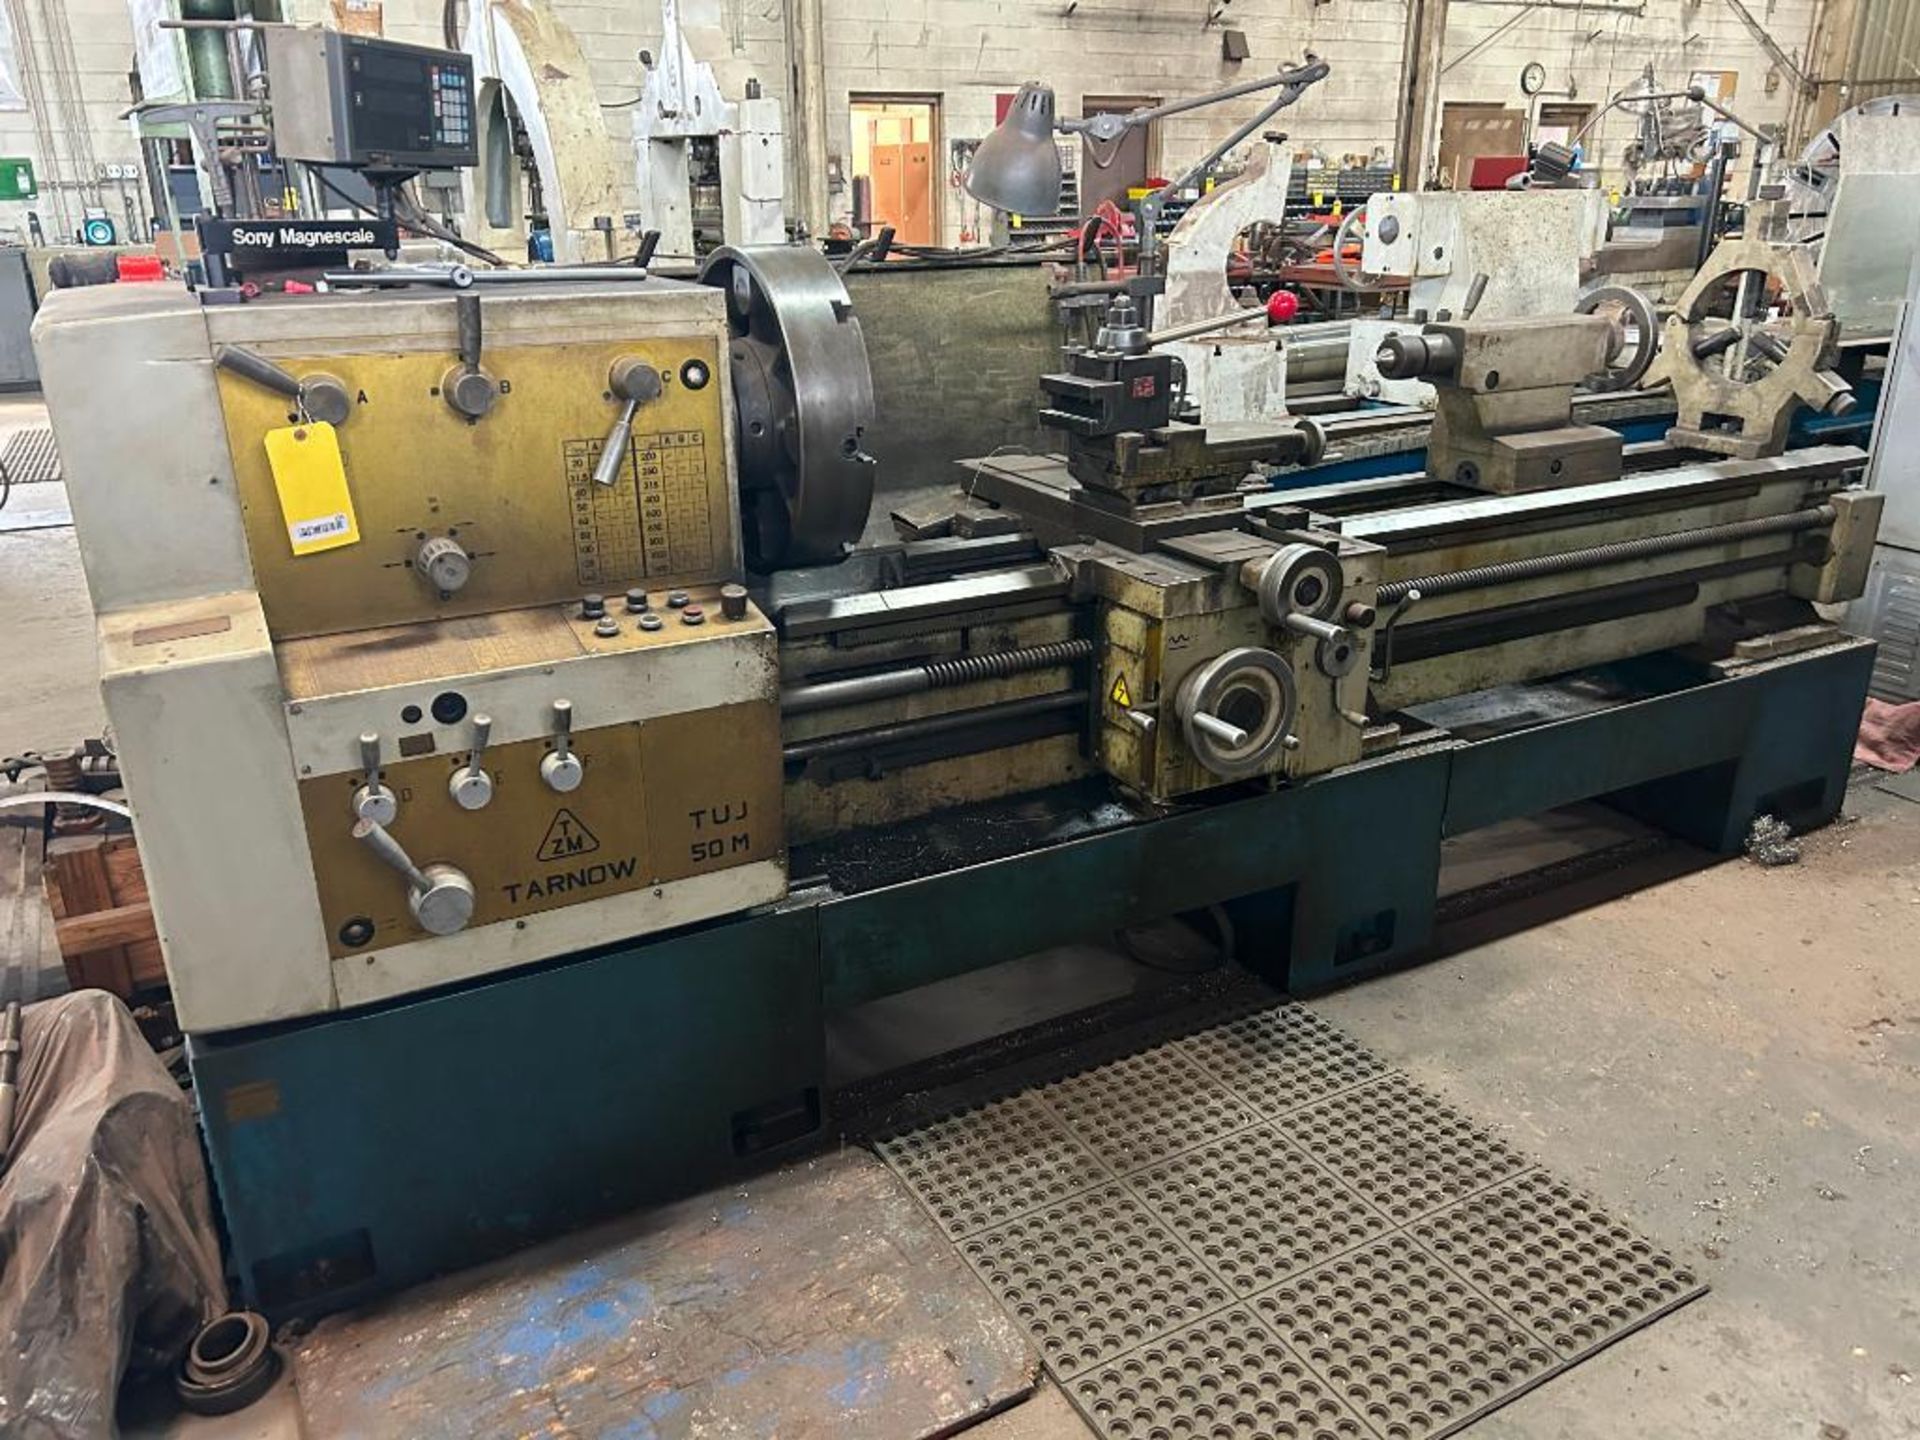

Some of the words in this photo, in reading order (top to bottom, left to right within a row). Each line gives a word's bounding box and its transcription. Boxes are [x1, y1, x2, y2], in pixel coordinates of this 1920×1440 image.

[232, 228, 274, 247] Sony
[280, 228, 375, 247] Magnescale
[661, 369, 671, 383] C
[500, 380, 511, 394] B
[356, 389, 369, 405] A
[689, 801, 748, 830] TUJ
[559, 820, 570, 836] T
[551, 836, 583, 855] ZM
[690, 839, 724, 863] 50
[732, 833, 750, 852] M
[503, 857, 637, 904] TARNOW
